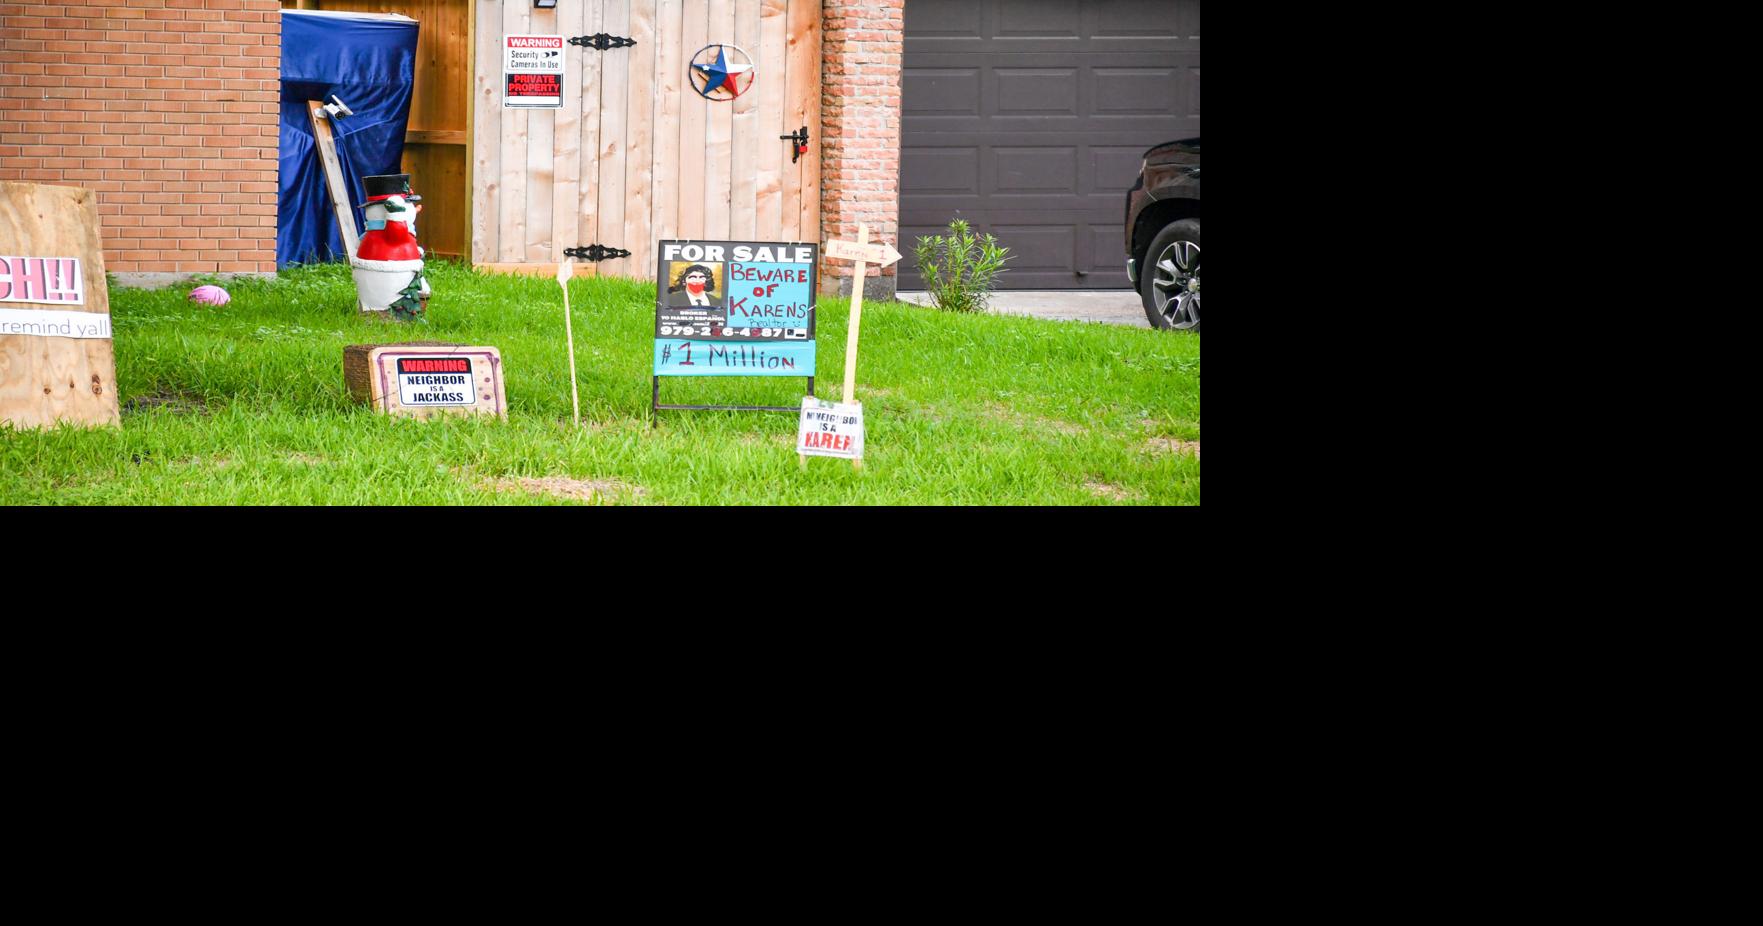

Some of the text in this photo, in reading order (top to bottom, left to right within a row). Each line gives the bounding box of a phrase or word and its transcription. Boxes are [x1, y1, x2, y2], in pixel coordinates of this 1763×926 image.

[510, 38, 560, 47] WARNING
[511, 50, 539, 59] Security
[511, 60, 538, 68] Cameras
[514, 75, 555, 83] PRIVATE
[509, 83, 560, 92] PROPERTY
[664, 245, 813, 263] FOR SALE
[731, 263, 808, 283] BEWARE
[753, 284, 779, 297] OF
[729, 296, 807, 318] KARENS
[2, 319, 108, 337] remind yall
[660, 326, 782, 337] 979-26-487
[708, 344, 795, 369] Million
[402, 360, 468, 372] WARNING
[407, 375, 465, 385] NEIGHBOR
[413, 393, 464, 402] JACKASS
